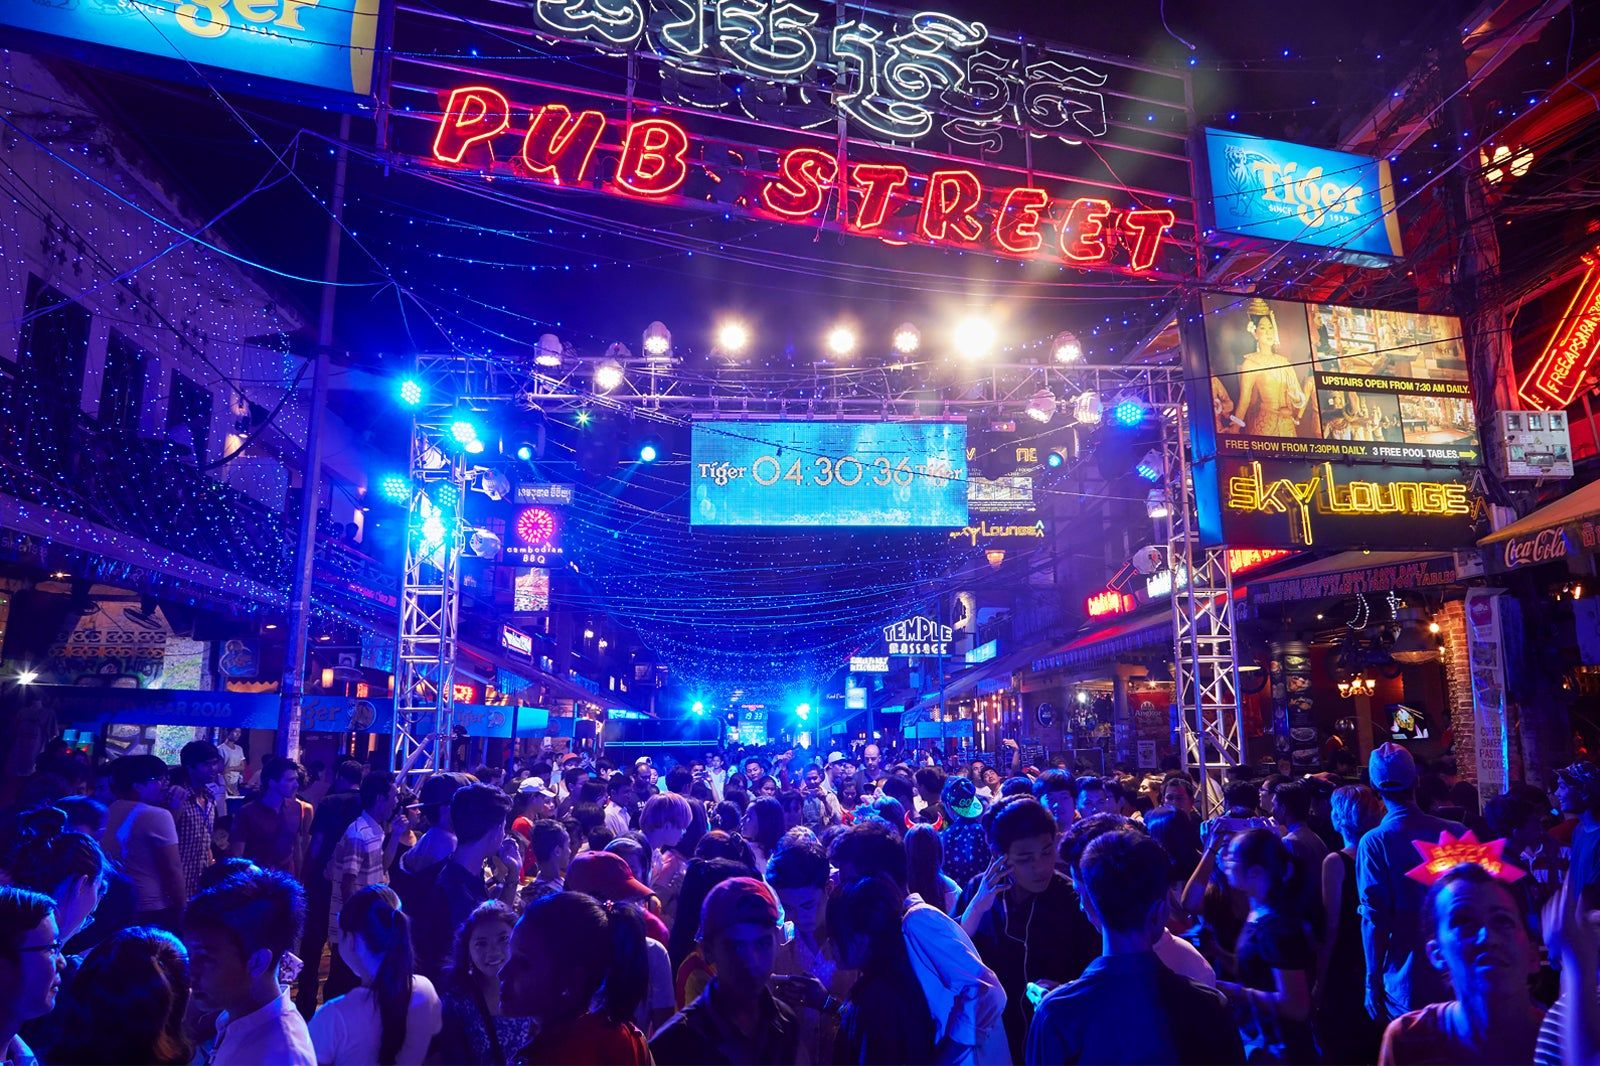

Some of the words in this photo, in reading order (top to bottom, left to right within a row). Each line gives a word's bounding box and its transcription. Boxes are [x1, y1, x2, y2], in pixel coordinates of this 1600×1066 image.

[433, 86, 688, 194] PUB
[763, 148, 1175, 270] STREET
[1252, 160, 1363, 228] Tiger
[1268, 204, 1293, 215] SINCE
[1321, 375, 1363, 388] UPSTAIRS
[1364, 378, 1388, 390] OPEN
[1389, 381, 1413, 391] FROM
[1415, 382, 1431, 392] 7:30
[1432, 383, 1445, 393] AM
[1446, 384, 1470, 394] DAILY.
[1225, 439, 1249, 450] FREE
[1251, 440, 1279, 452] SHOW
[1281, 442, 1308, 453] FROM
[1309, 443, 1340, 454] 7:30PM
[1341, 445, 1368, 456] DAILY.
[1372, 446, 1379, 456] 3
[1380, 447, 1401, 457] FREE
[1402, 448, 1426, 458] POOL
[1427, 449, 1460, 459] TABLES.
[698, 461, 746, 486] Tiger
[506, 545, 563, 554] cambodian
[1504, 526, 1566, 568] Coca-Cola
[522, 554, 545, 564] BBQ
[1416, 570, 1456, 586] TABLES
[883, 616, 952, 642] TEMPLE
[889, 642, 947, 655] MASSAGE
[191, 702, 232, 718] 2016
